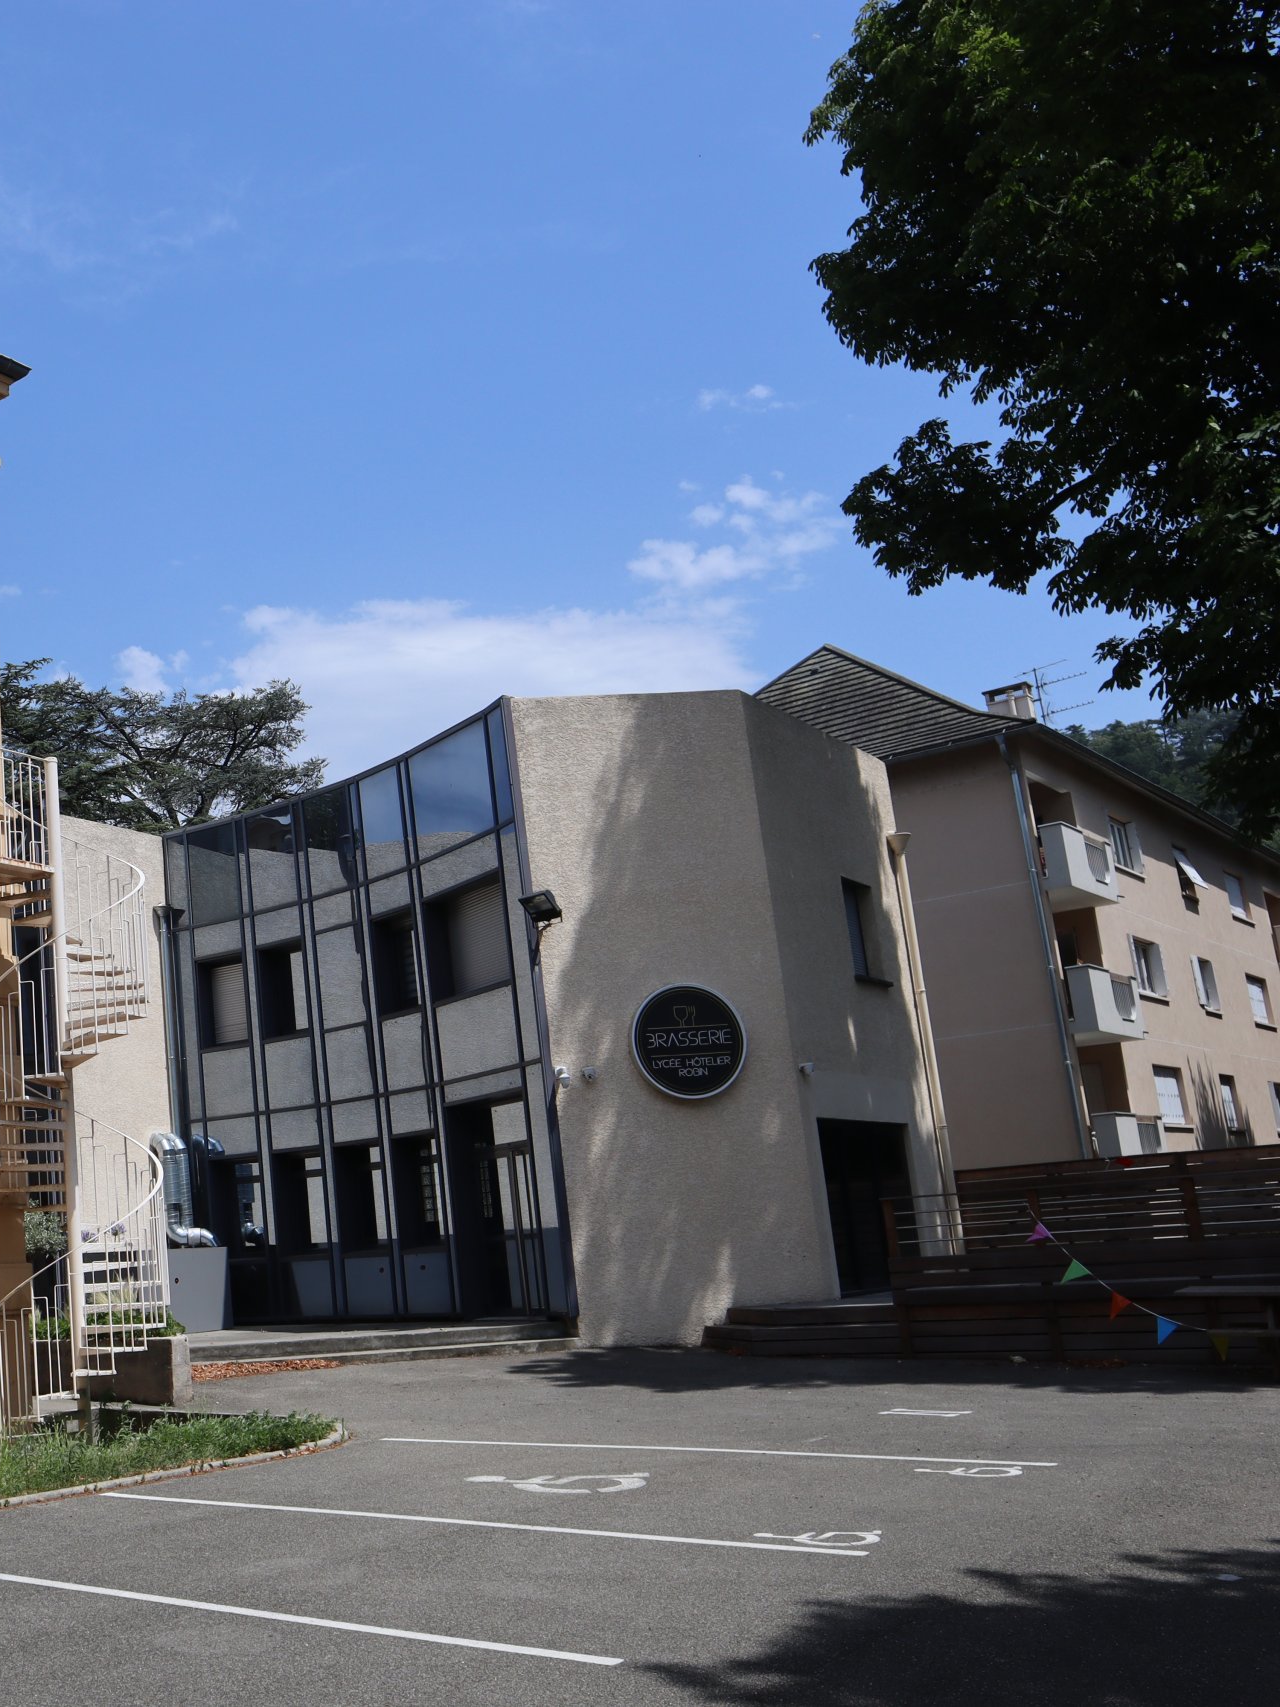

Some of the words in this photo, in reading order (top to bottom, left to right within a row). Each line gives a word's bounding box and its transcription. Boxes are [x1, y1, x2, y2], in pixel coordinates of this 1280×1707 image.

[645, 1028, 733, 1049] BRASSERIE
[652, 1057, 682, 1069] LYCÉE
[686, 1055, 731, 1067] HÔTELIER
[678, 1067, 709, 1078] ROBIN
